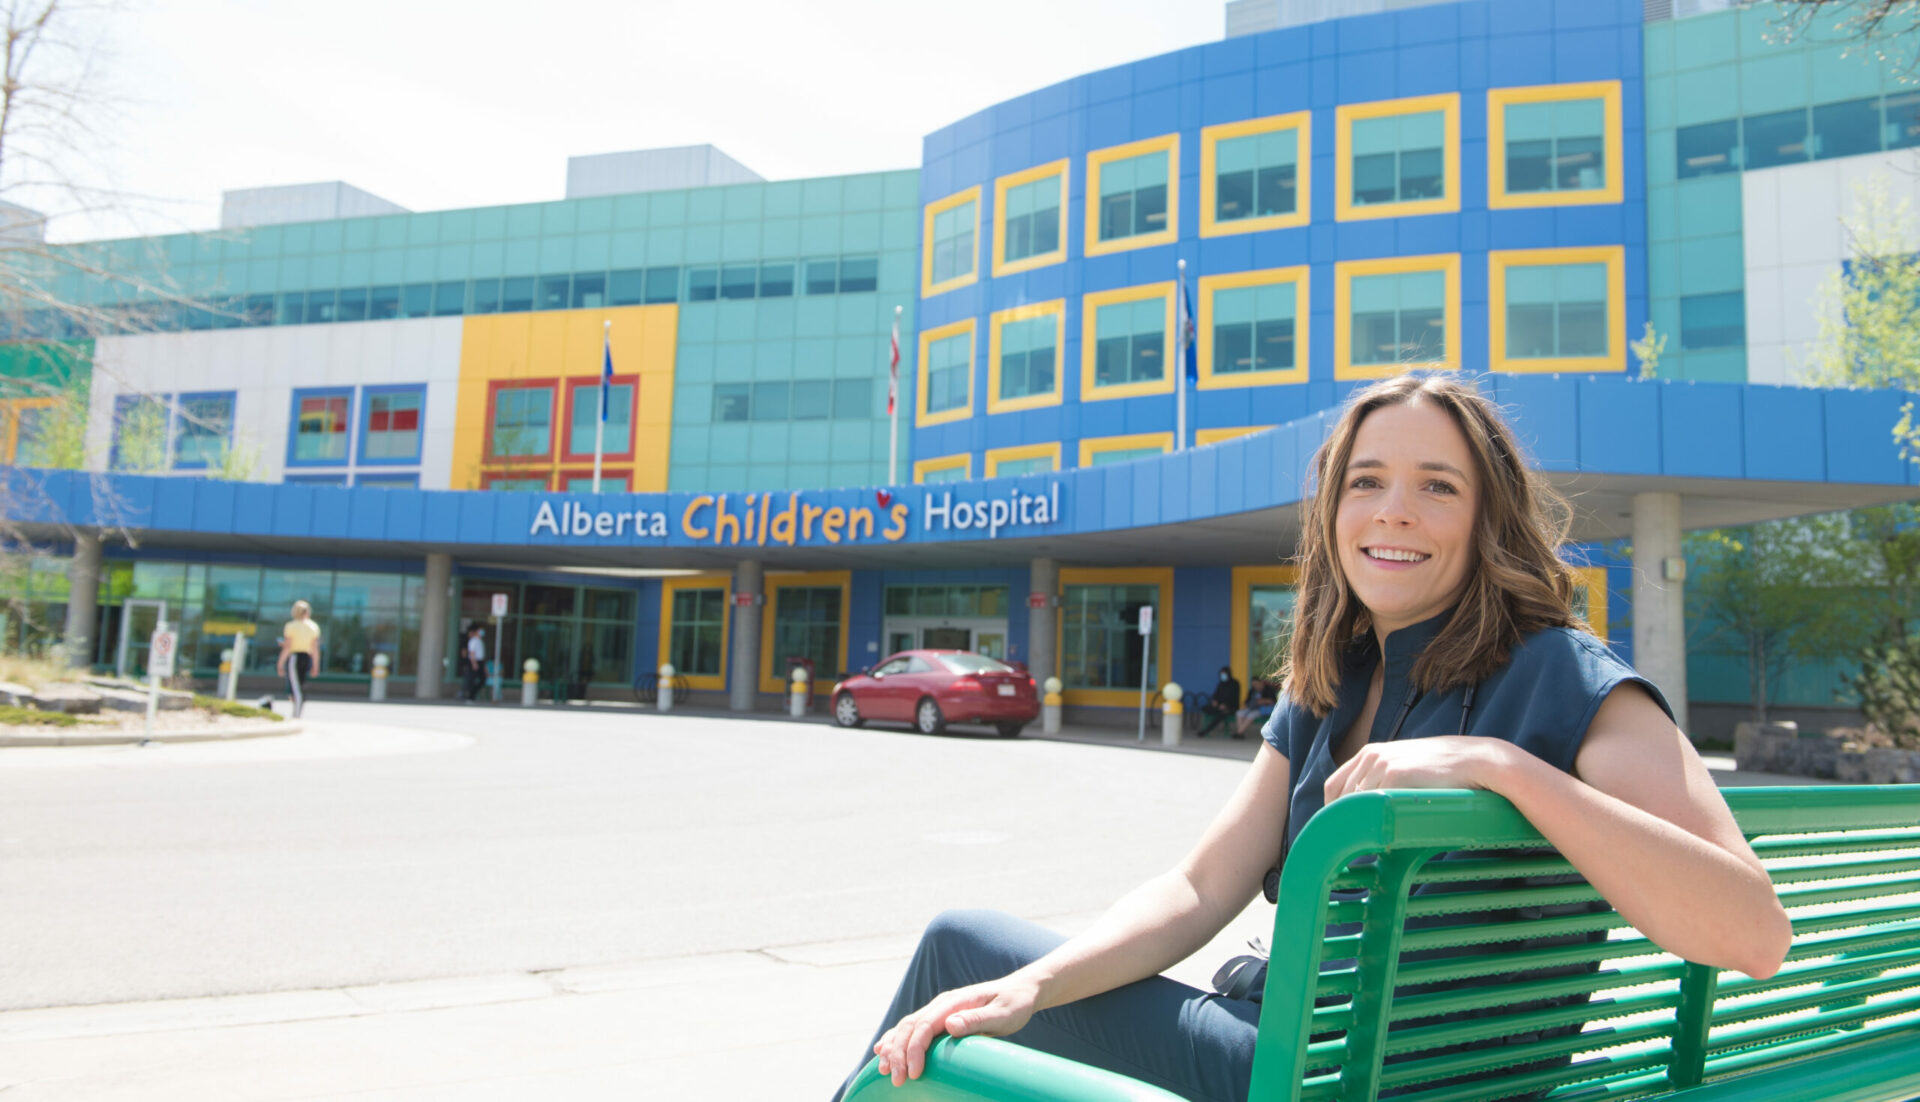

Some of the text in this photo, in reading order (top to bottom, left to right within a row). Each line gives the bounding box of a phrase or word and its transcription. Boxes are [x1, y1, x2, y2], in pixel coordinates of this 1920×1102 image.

[531, 482, 1058, 546] Alberta Children's Hospital
